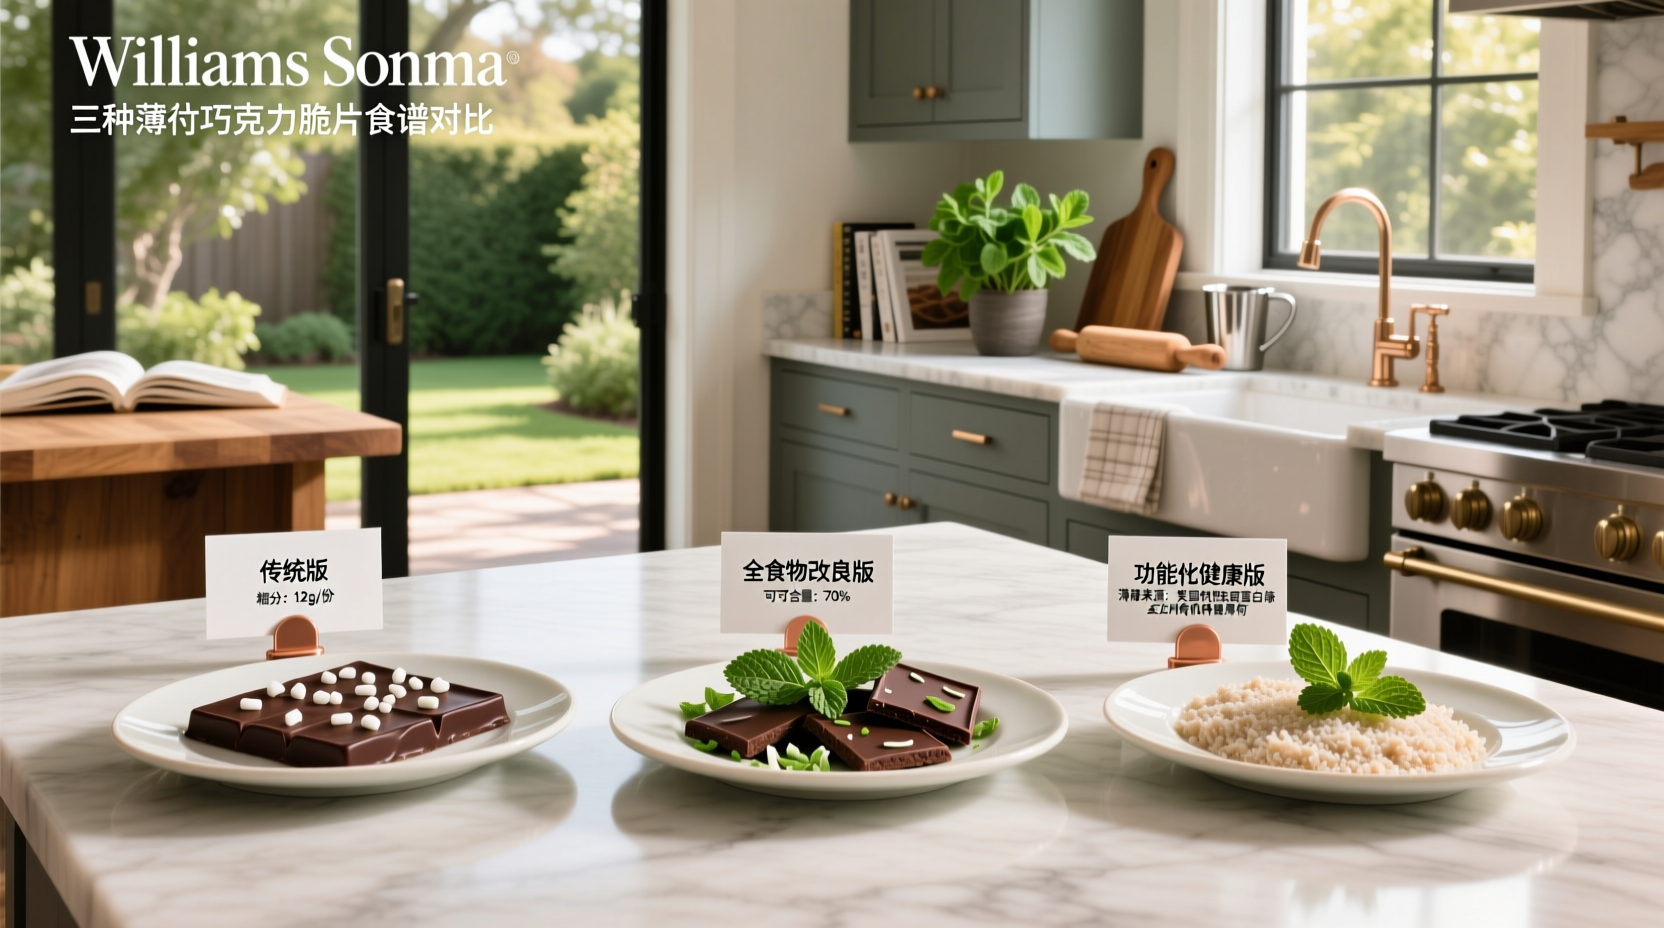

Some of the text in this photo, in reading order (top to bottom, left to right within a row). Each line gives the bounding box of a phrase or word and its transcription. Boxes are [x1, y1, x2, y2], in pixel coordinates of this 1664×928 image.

[259, 558, 329, 584] 传统版
[742, 558, 875, 584] 全食物改良版
